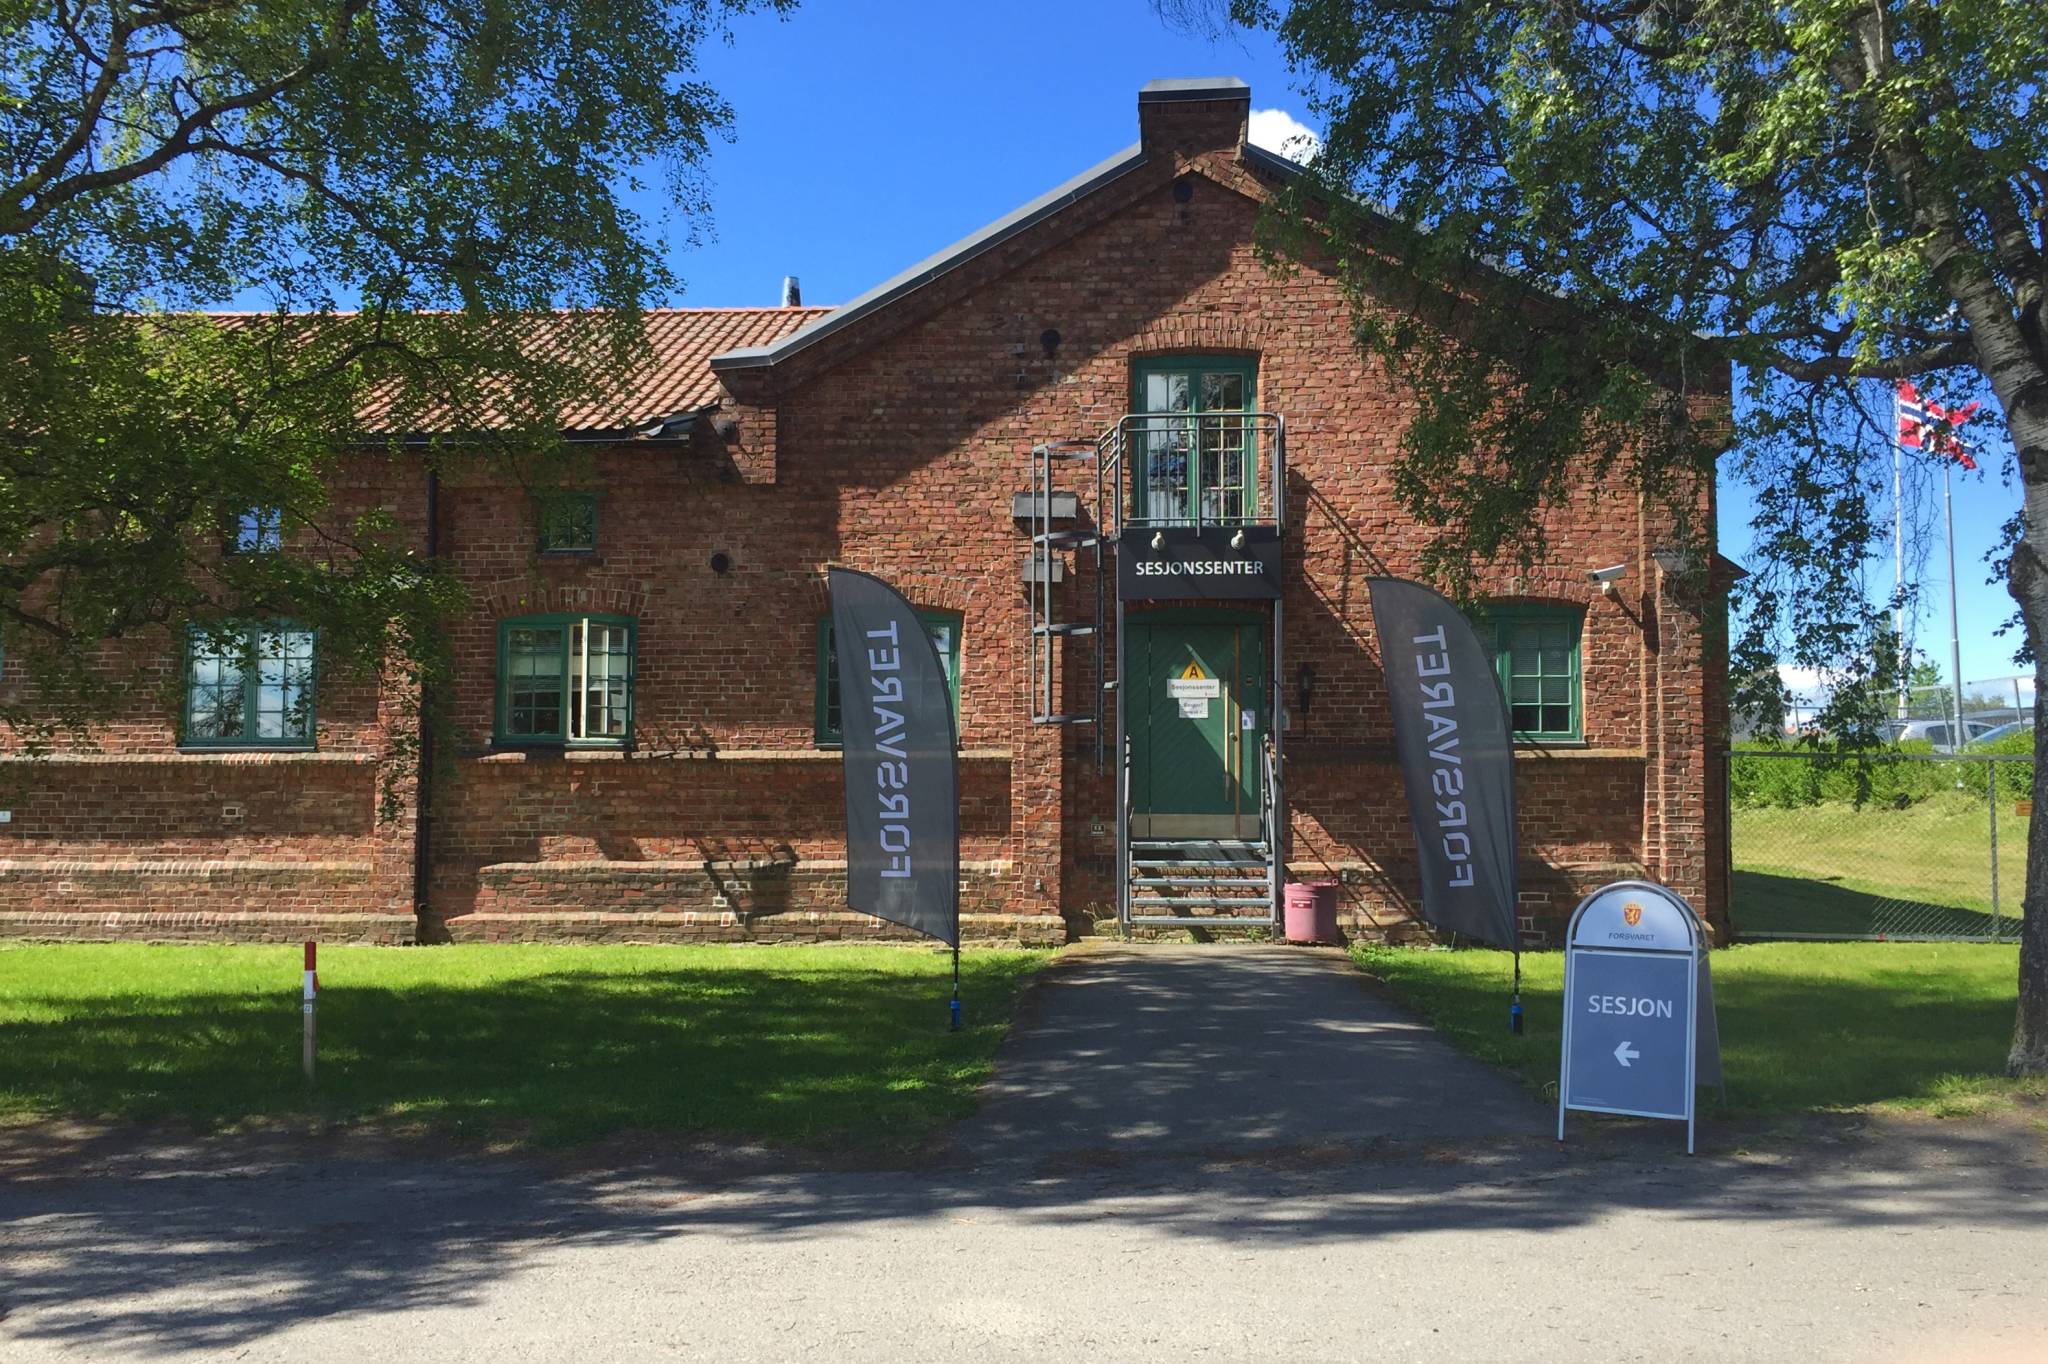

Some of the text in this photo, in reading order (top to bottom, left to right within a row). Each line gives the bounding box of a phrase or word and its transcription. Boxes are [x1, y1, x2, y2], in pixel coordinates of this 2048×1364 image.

[1136, 561, 1263, 575] SESJONSSENTER
[1608, 932, 1655, 941] FORSVARET
[1588, 995, 1672, 1018] SESJON
